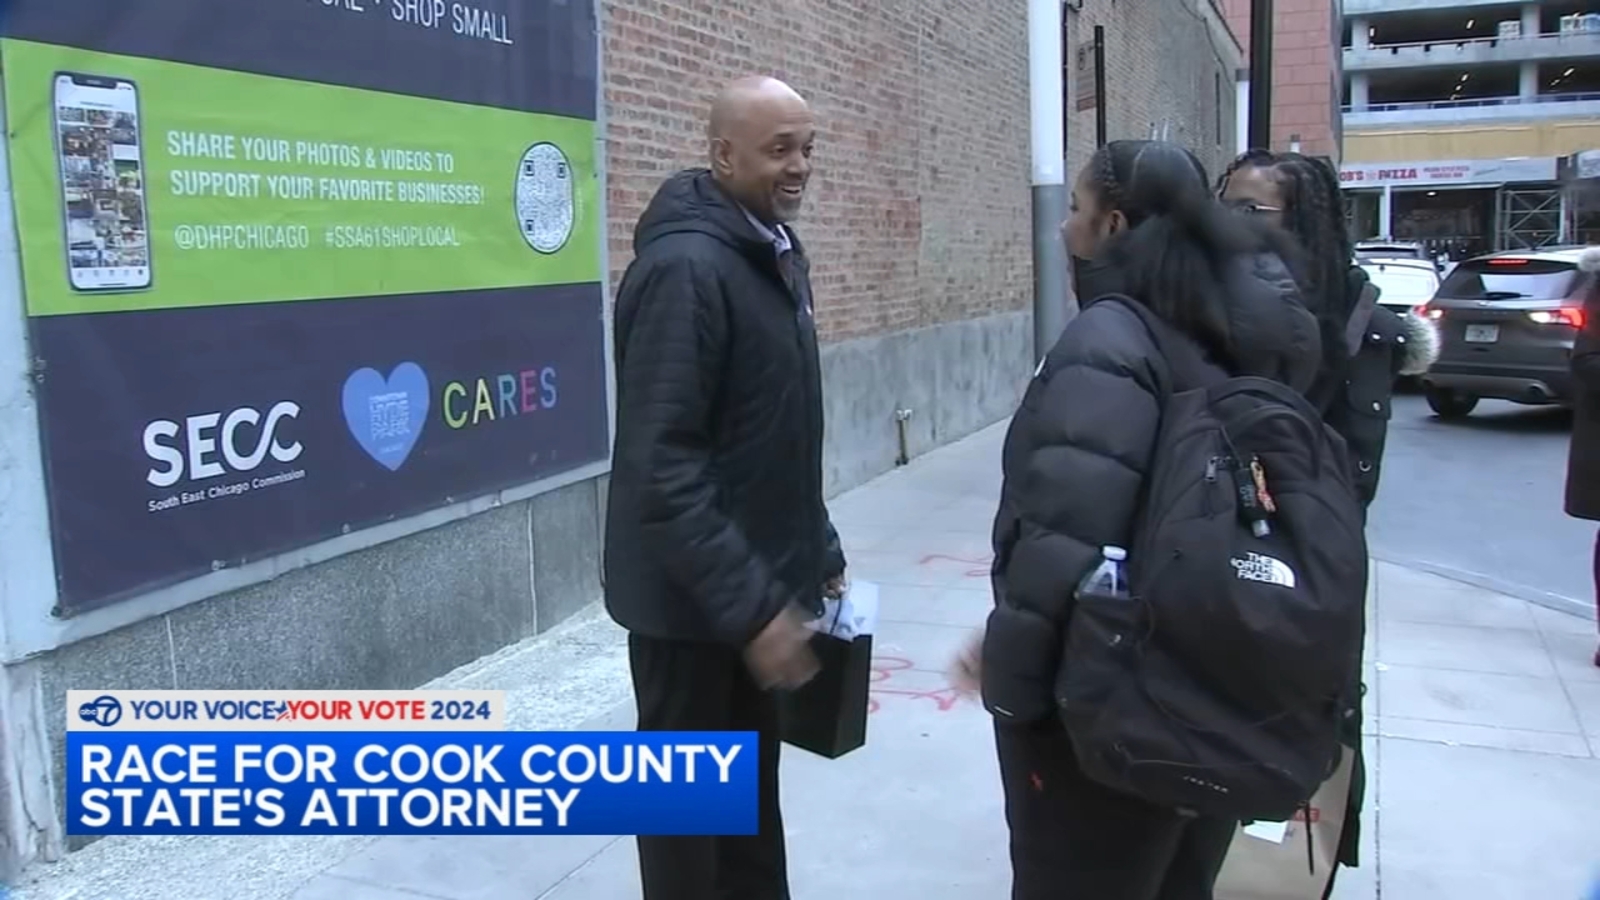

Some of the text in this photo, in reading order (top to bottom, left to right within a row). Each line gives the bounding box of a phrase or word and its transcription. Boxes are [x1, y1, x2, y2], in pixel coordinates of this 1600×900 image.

[392, 0, 514, 45] SHOP SMALL
[167, 130, 454, 173] SHARE YOUR PHOTOS & VIDEOS TO
[170, 169, 485, 205] SUPPORT YOUR FAVORITE BUSINESSES!
[174, 224, 461, 250] @DHPCHICAGO #SSA61SHOPLOCAL
[442, 366, 558, 429] CARES
[142, 401, 303, 487] SECC
[148, 469, 306, 512] South East Chicago Commission
